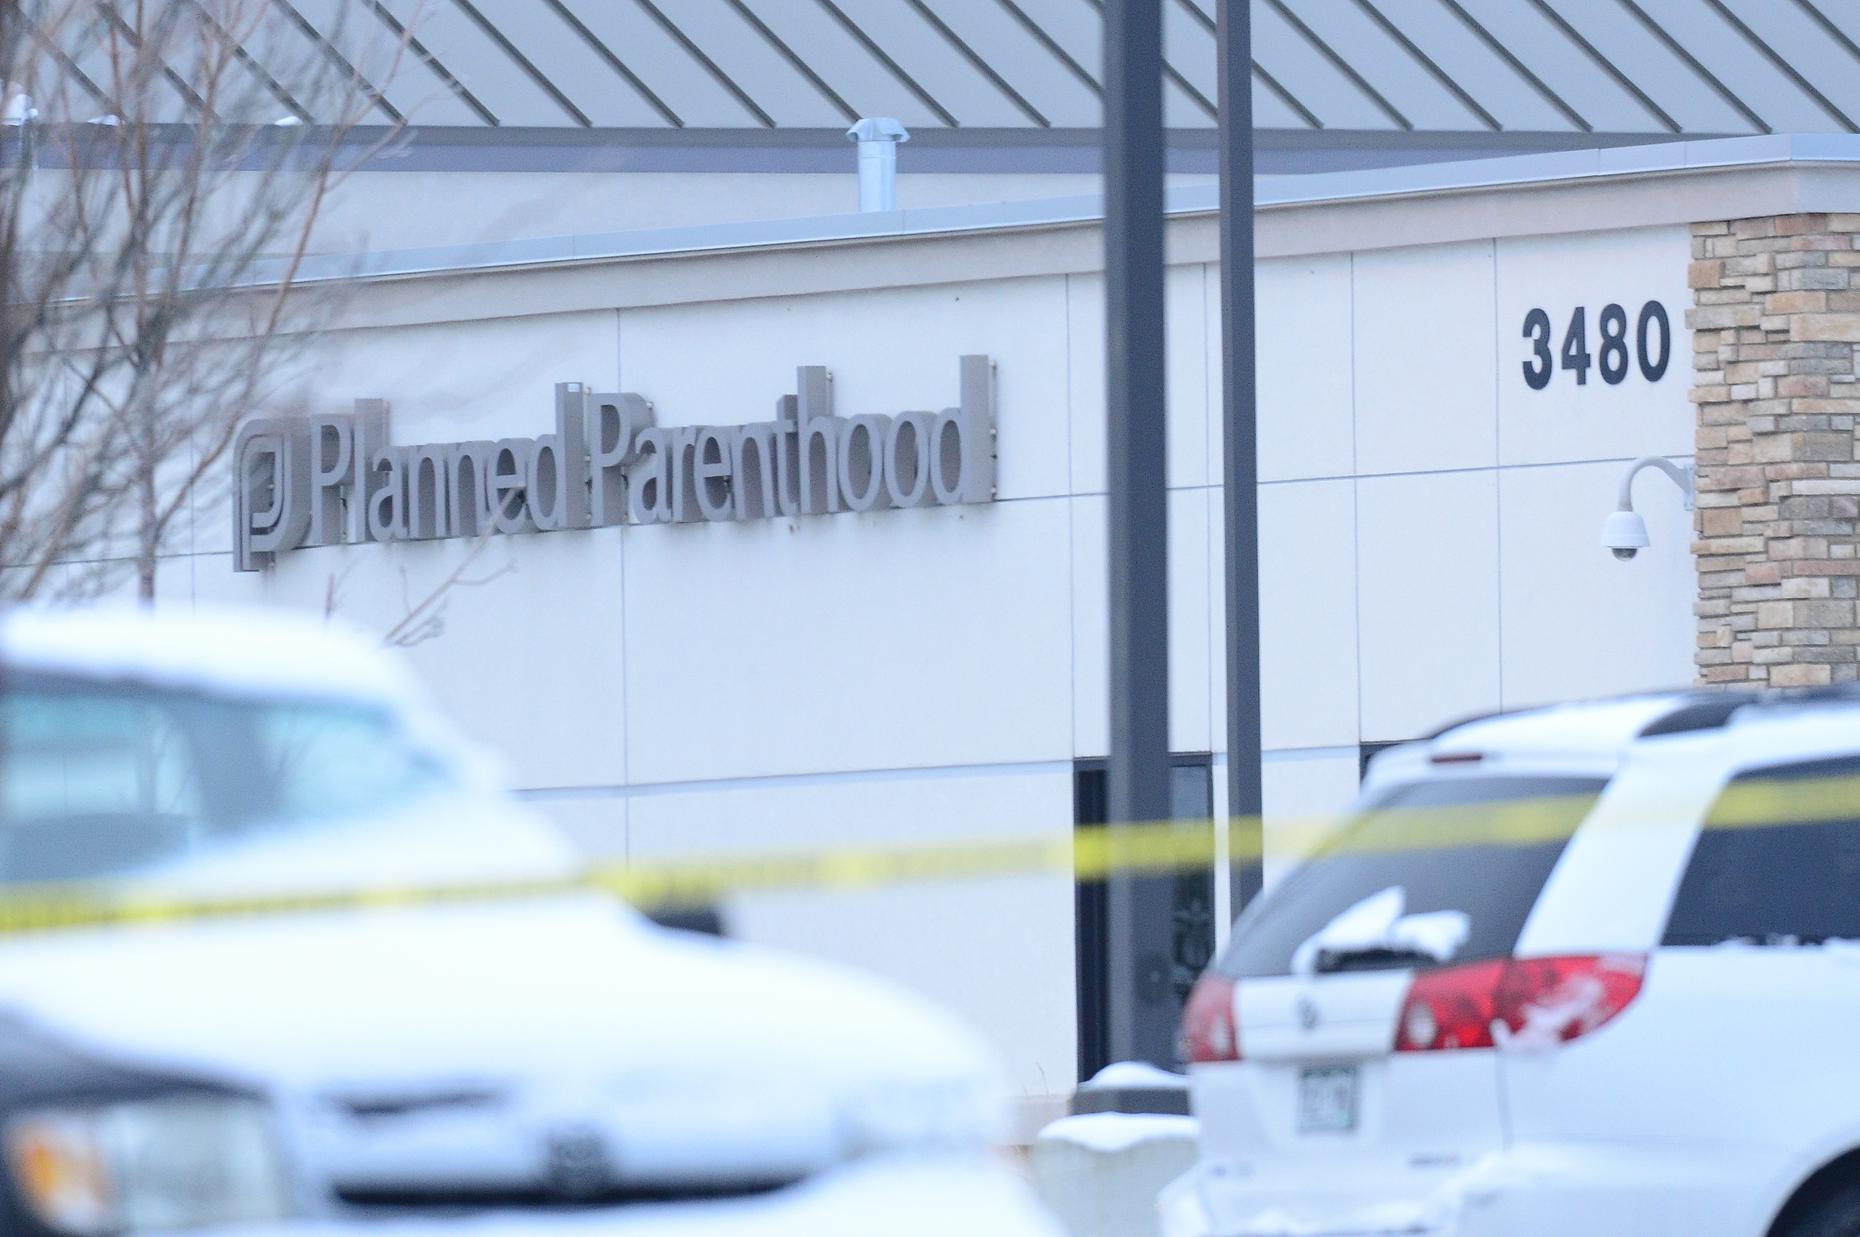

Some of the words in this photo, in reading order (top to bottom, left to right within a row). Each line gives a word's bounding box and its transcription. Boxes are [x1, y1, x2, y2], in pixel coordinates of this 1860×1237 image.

[1522, 300, 1671, 390] 3480
[311, 382, 584, 543] Planned
[590, 354, 989, 526] Parenthood
